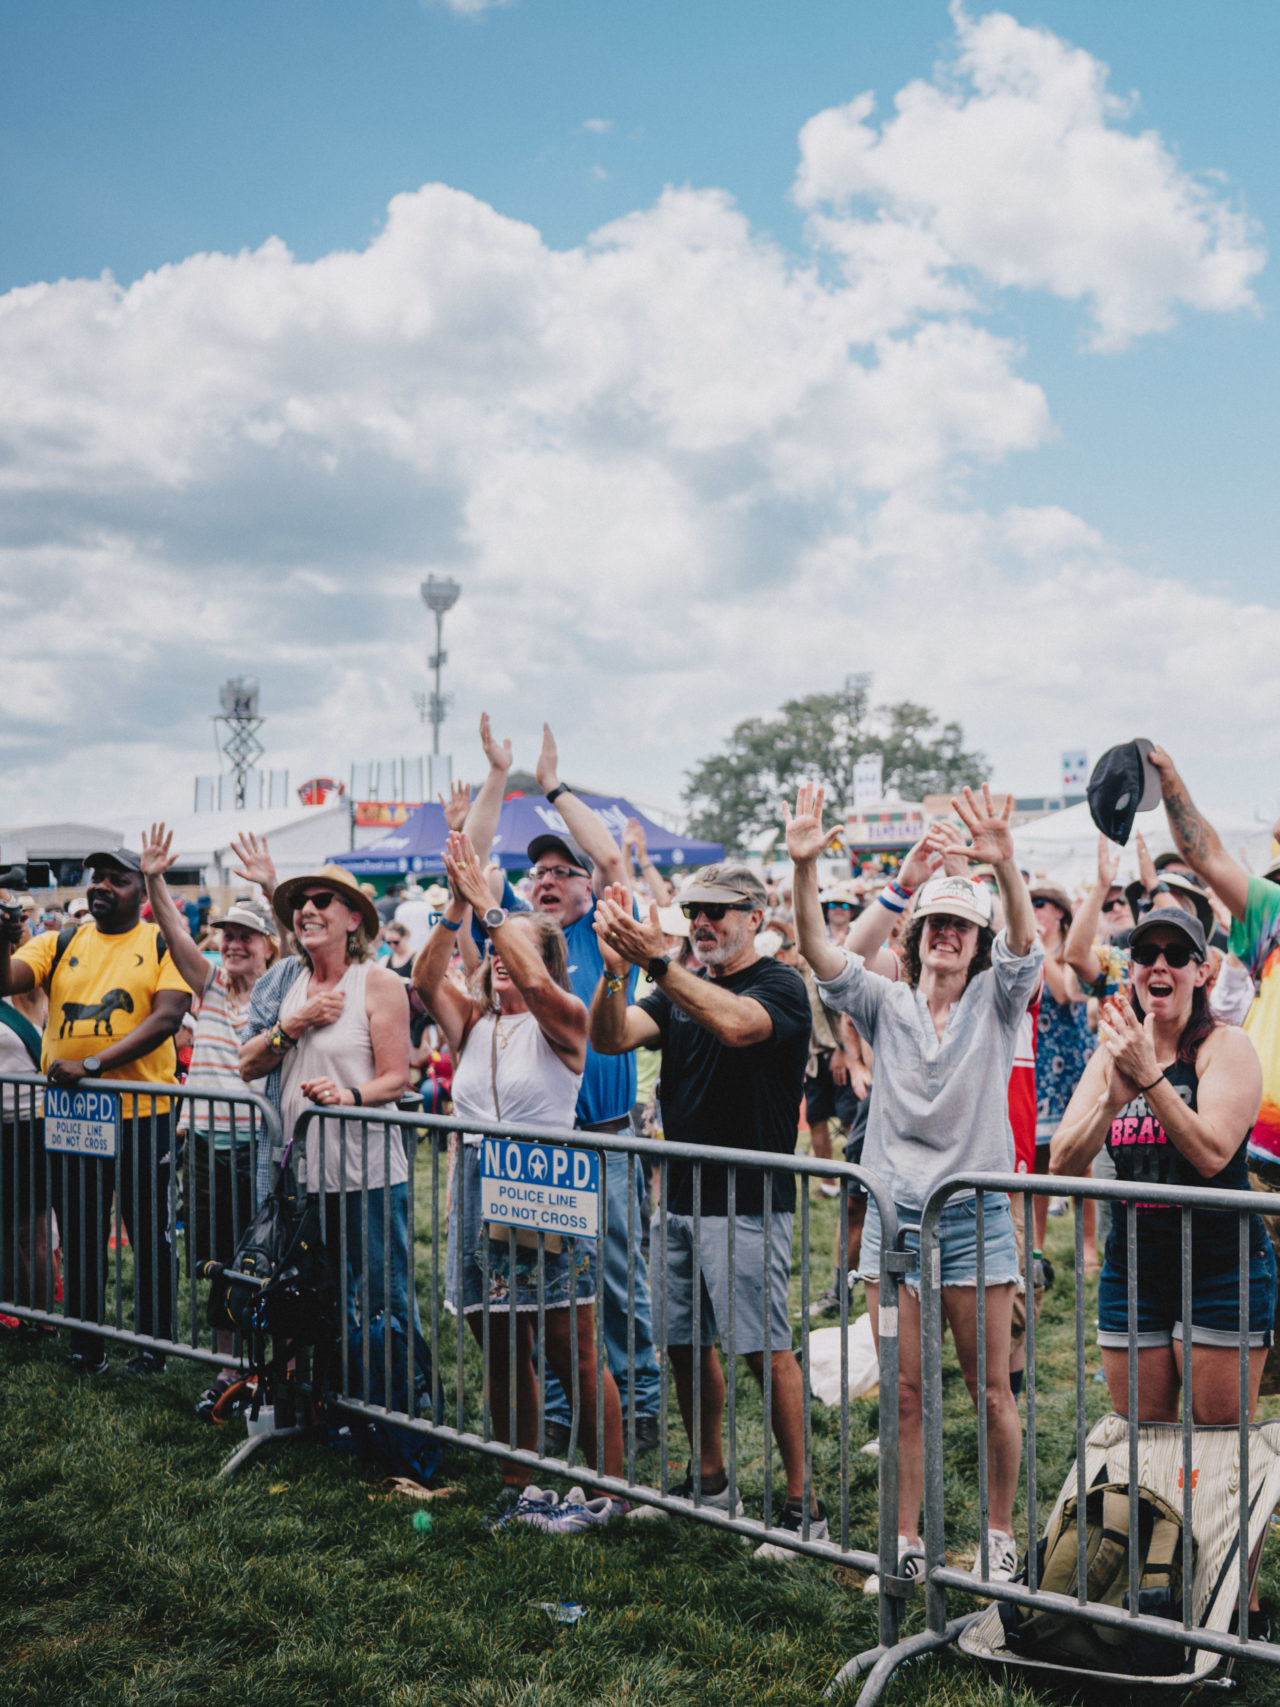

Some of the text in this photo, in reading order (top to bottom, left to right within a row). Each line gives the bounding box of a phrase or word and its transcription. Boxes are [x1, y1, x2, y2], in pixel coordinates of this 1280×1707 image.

[56, 1121, 103, 1137] POLICE LINE
[52, 1134, 107, 1151] DO NOT CROSS
[499, 1186, 577, 1209] POLICE LINE
[490, 1202, 588, 1229] DO NOT CROSS
